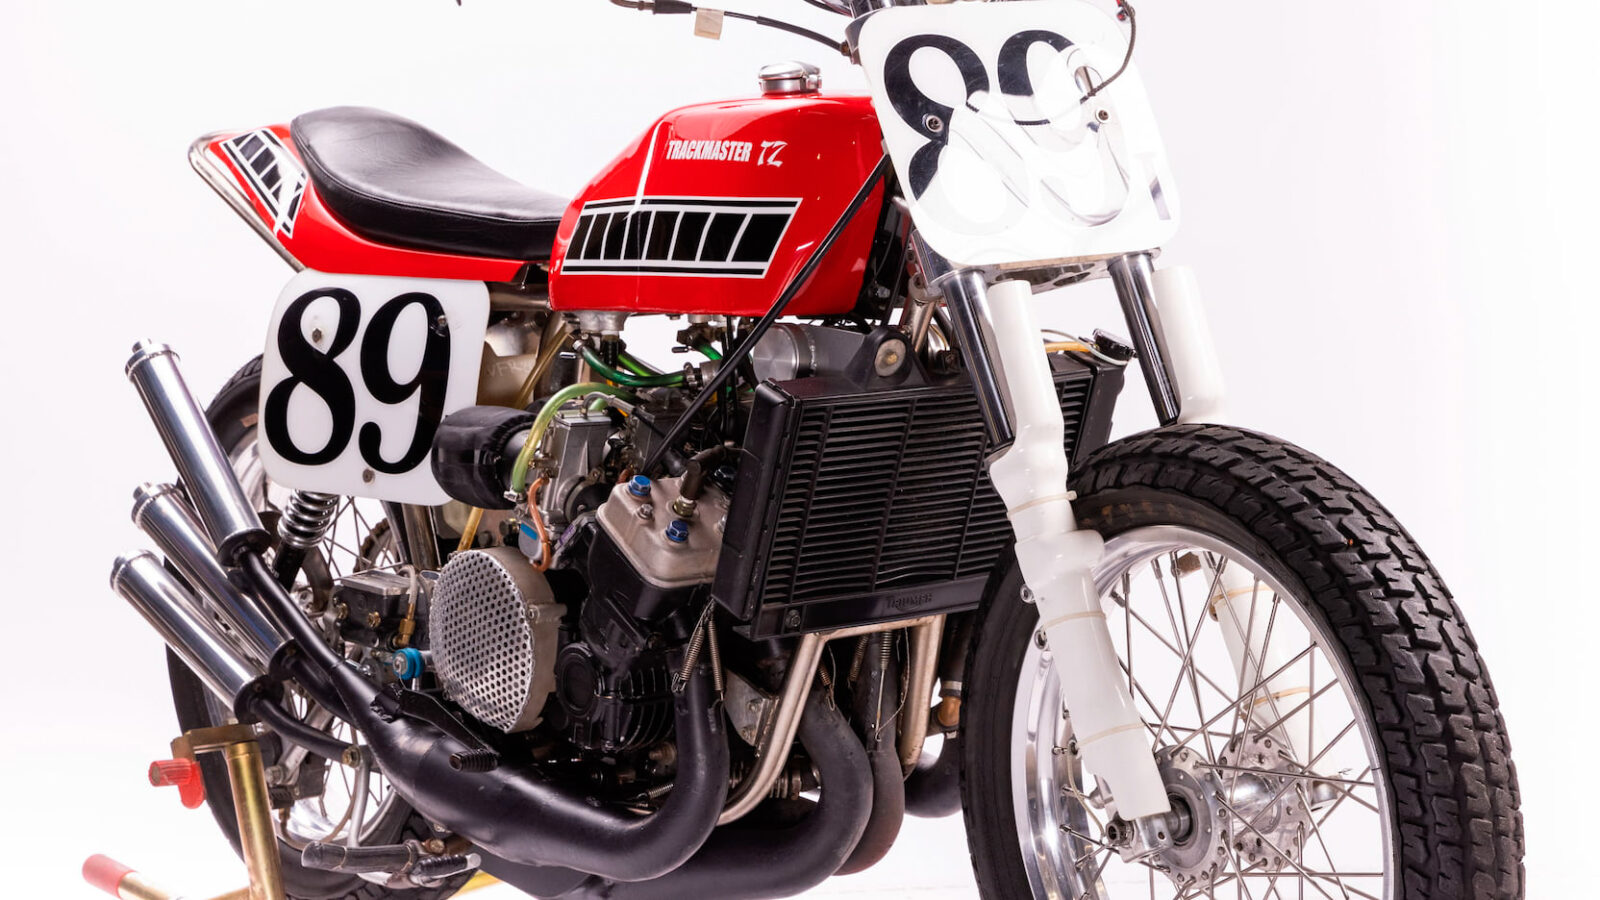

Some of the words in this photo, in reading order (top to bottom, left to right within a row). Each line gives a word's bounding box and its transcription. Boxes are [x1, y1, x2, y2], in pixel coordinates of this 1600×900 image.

[666, 140, 753, 162] TRACKMASTER
[757, 140, 788, 167] TZ
[264, 287, 451, 475] 89
[885, 592, 933, 611] TRIUMPH
